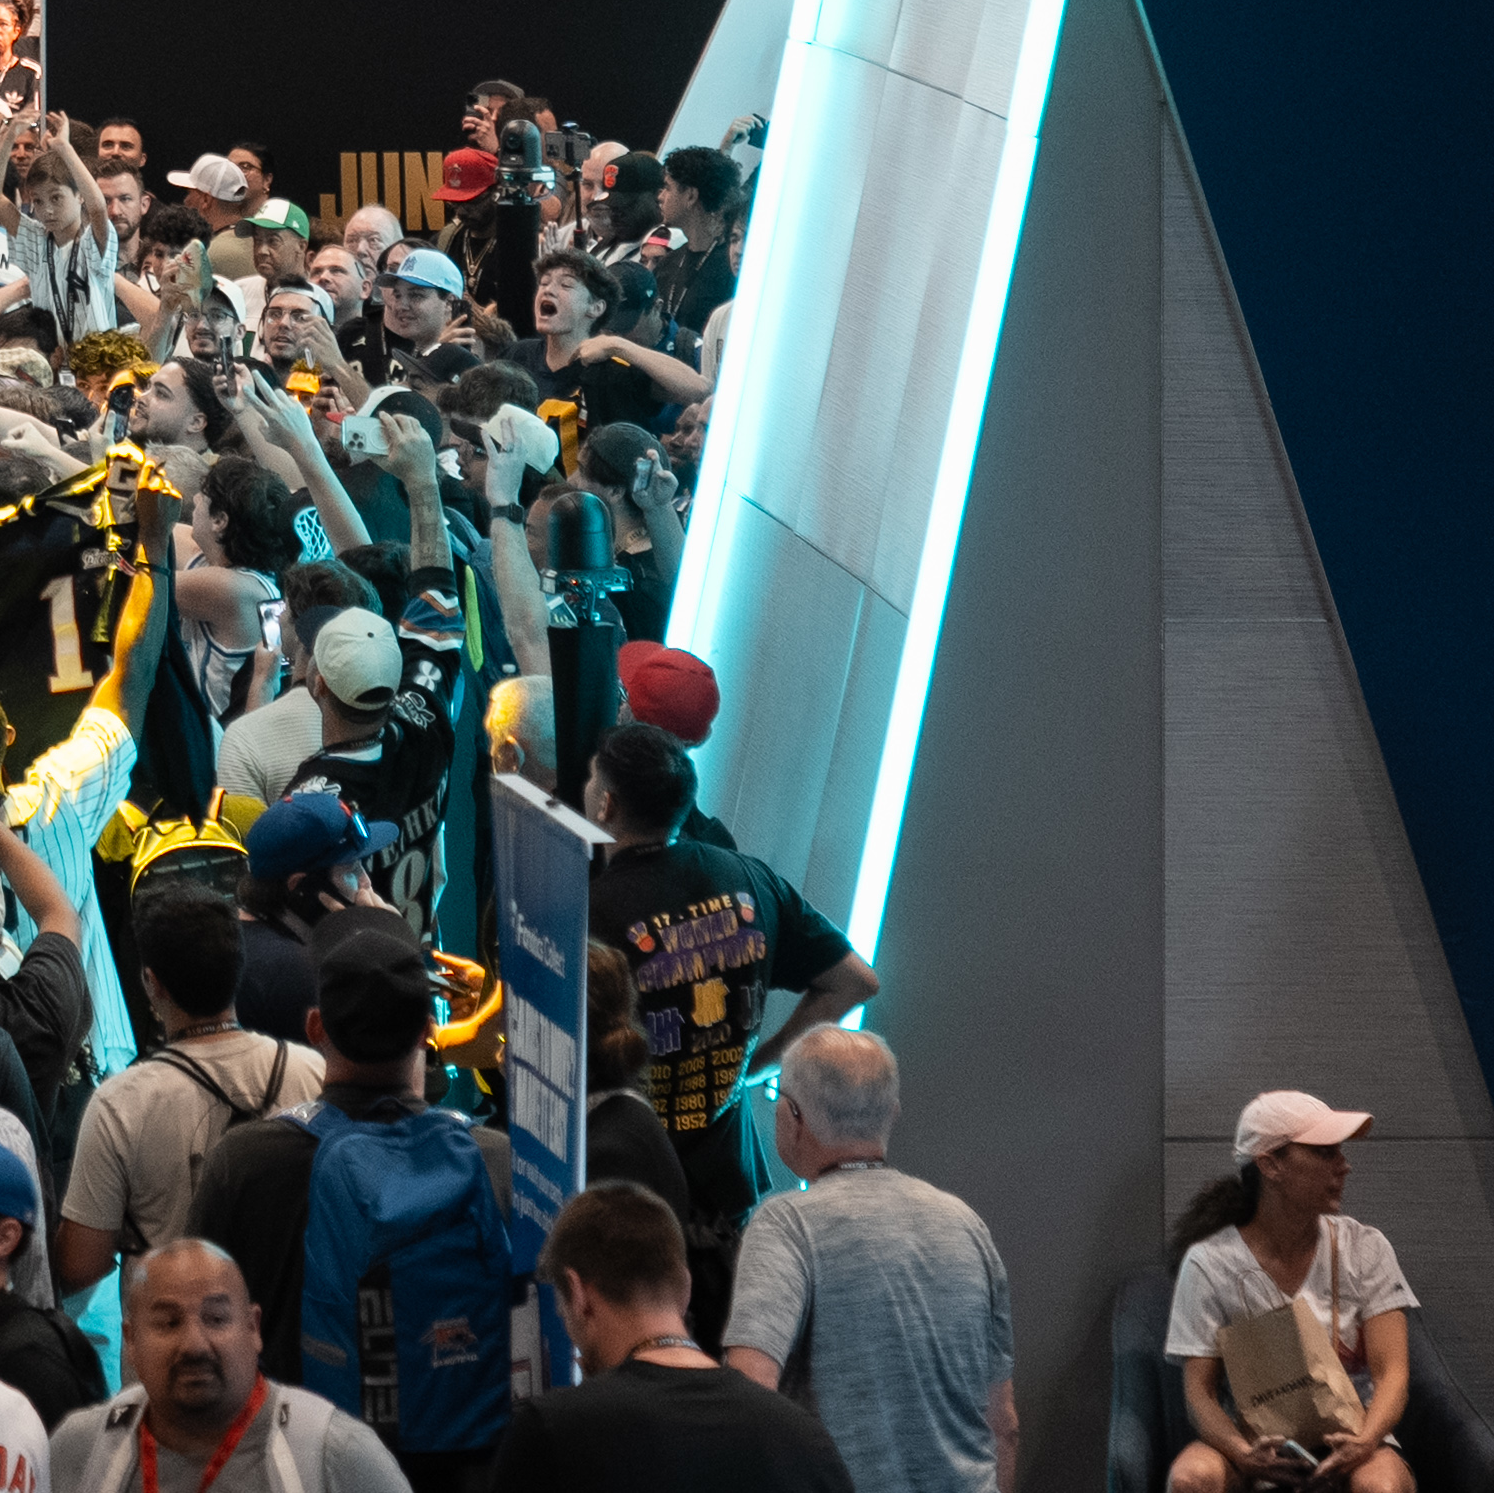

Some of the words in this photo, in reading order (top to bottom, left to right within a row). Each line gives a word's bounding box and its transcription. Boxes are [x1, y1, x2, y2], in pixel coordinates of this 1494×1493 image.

[653, 913, 671, 928] 17
[688, 894, 732, 918] TIME
[675, 1095, 707, 1112] 1980
[675, 1113, 707, 1132] 1952
